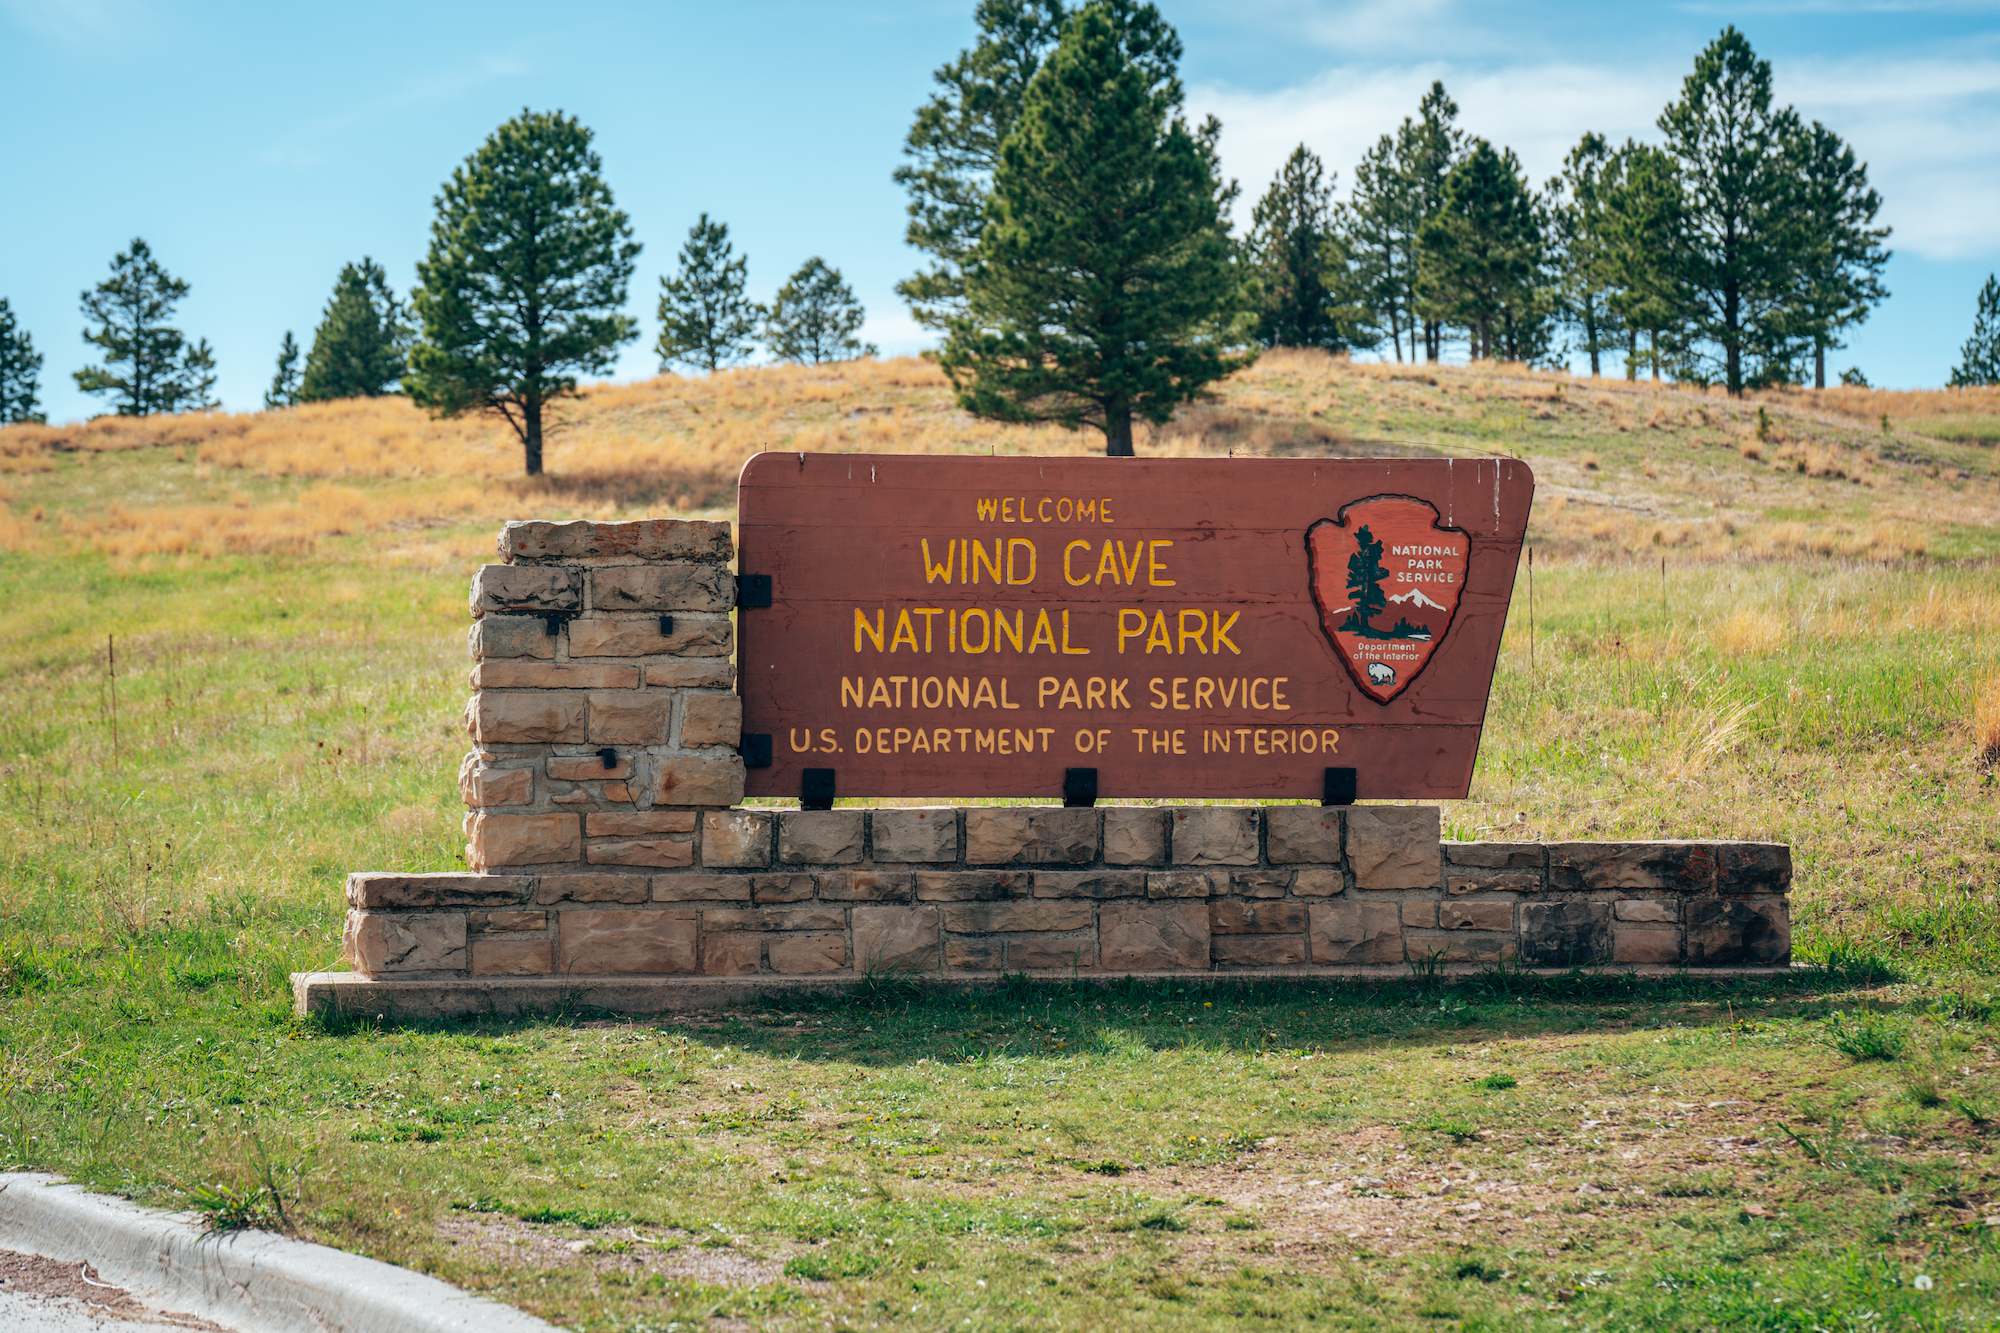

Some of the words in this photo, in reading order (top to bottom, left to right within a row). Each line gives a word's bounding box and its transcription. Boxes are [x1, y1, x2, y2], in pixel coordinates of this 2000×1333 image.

[976, 497, 1114, 524] WELCOME
[1392, 545, 1459, 556] NATIONAL
[921, 537, 1037, 585] WIND
[1063, 539, 1177, 587] CAVE
[1408, 559, 1443, 570] PARK
[1396, 572, 1455, 583] SERVICE
[853, 607, 1091, 655] NATIONAL
[1117, 608, 1242, 655] PARK
[1353, 652, 1363, 660] of
[1364, 652, 1381, 661] the
[1383, 652, 1420, 661] Interior
[1358, 642, 1416, 652] Department
[840, 676, 1020, 710] NATIONAL
[1038, 676, 1131, 711] PARK
[1149, 676, 1291, 711] SERVICE
[790, 727, 843, 754] U.S.
[855, 727, 1056, 755] DEPARTMENT
[1074, 728, 1112, 754] OF
[1131, 728, 1187, 755] THE
[1203, 728, 1341, 755] INTERIOR
